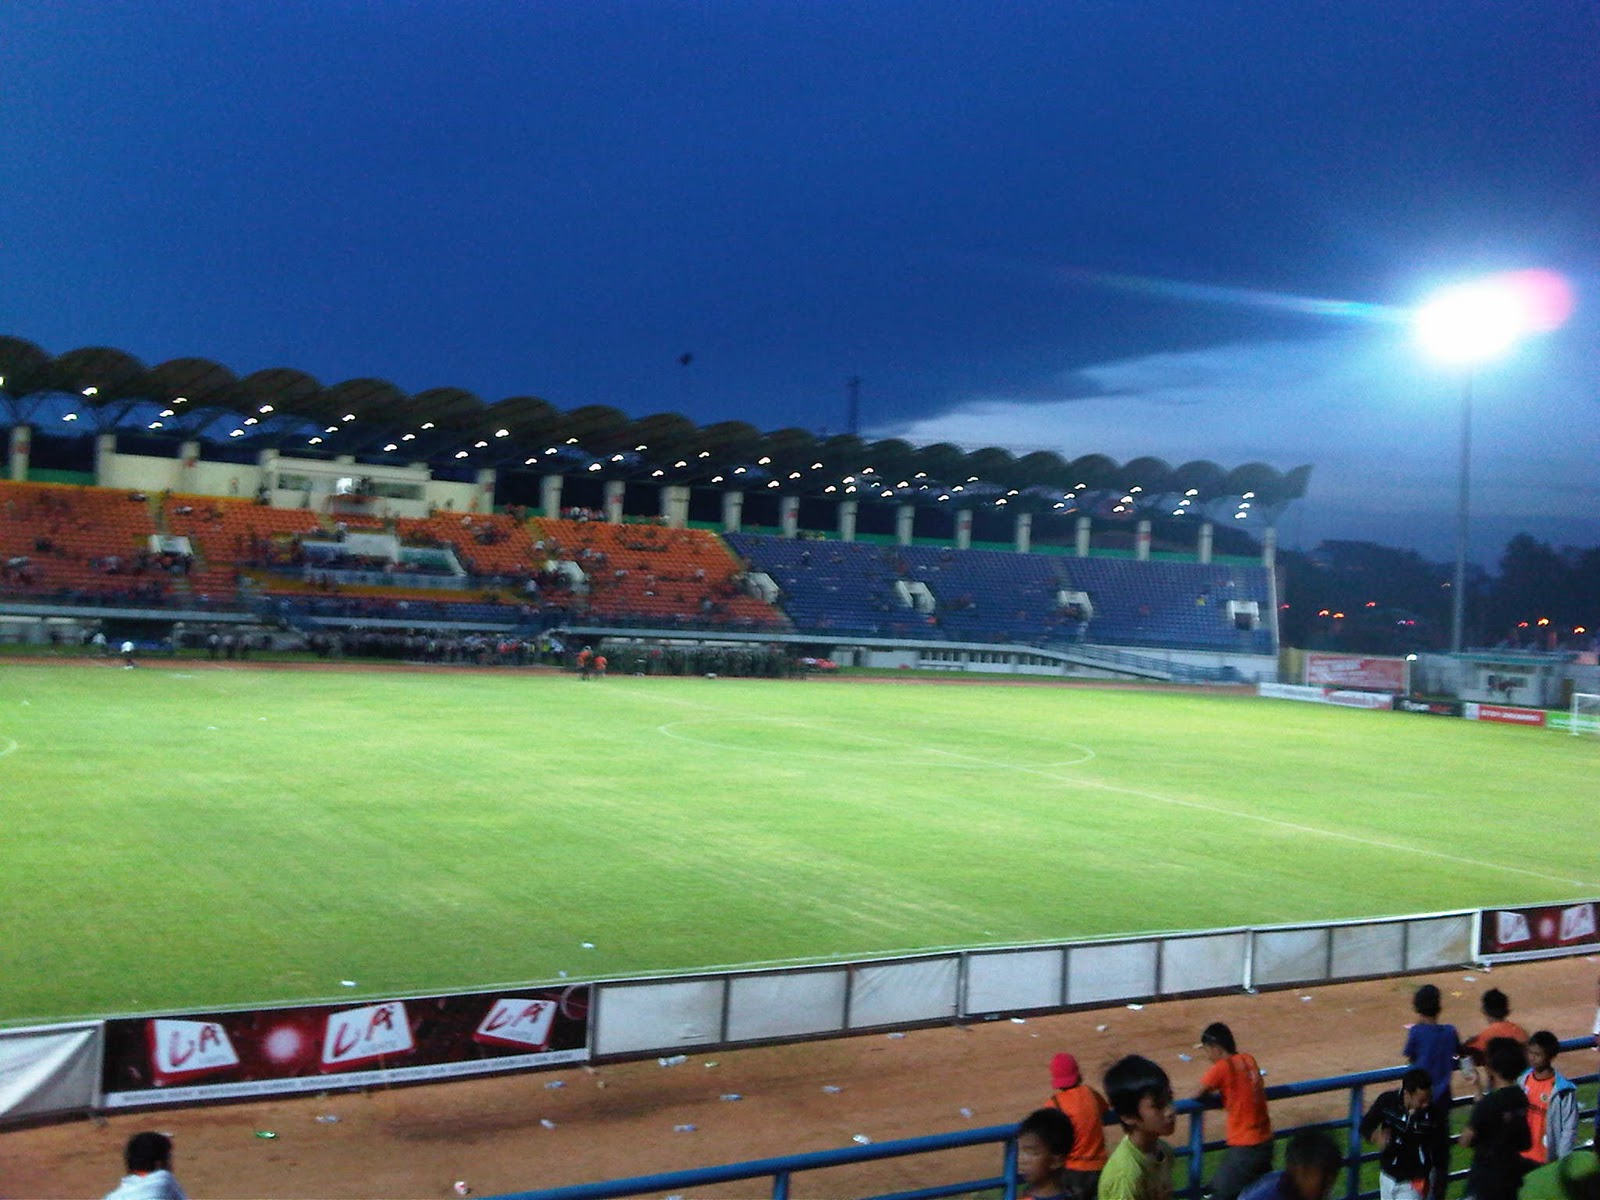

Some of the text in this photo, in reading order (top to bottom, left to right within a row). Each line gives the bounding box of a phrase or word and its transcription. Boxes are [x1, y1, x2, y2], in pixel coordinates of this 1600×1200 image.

[333, 1006, 393, 1057] LA
[485, 1003, 543, 1031] LA
[169, 1024, 220, 1067] LA
